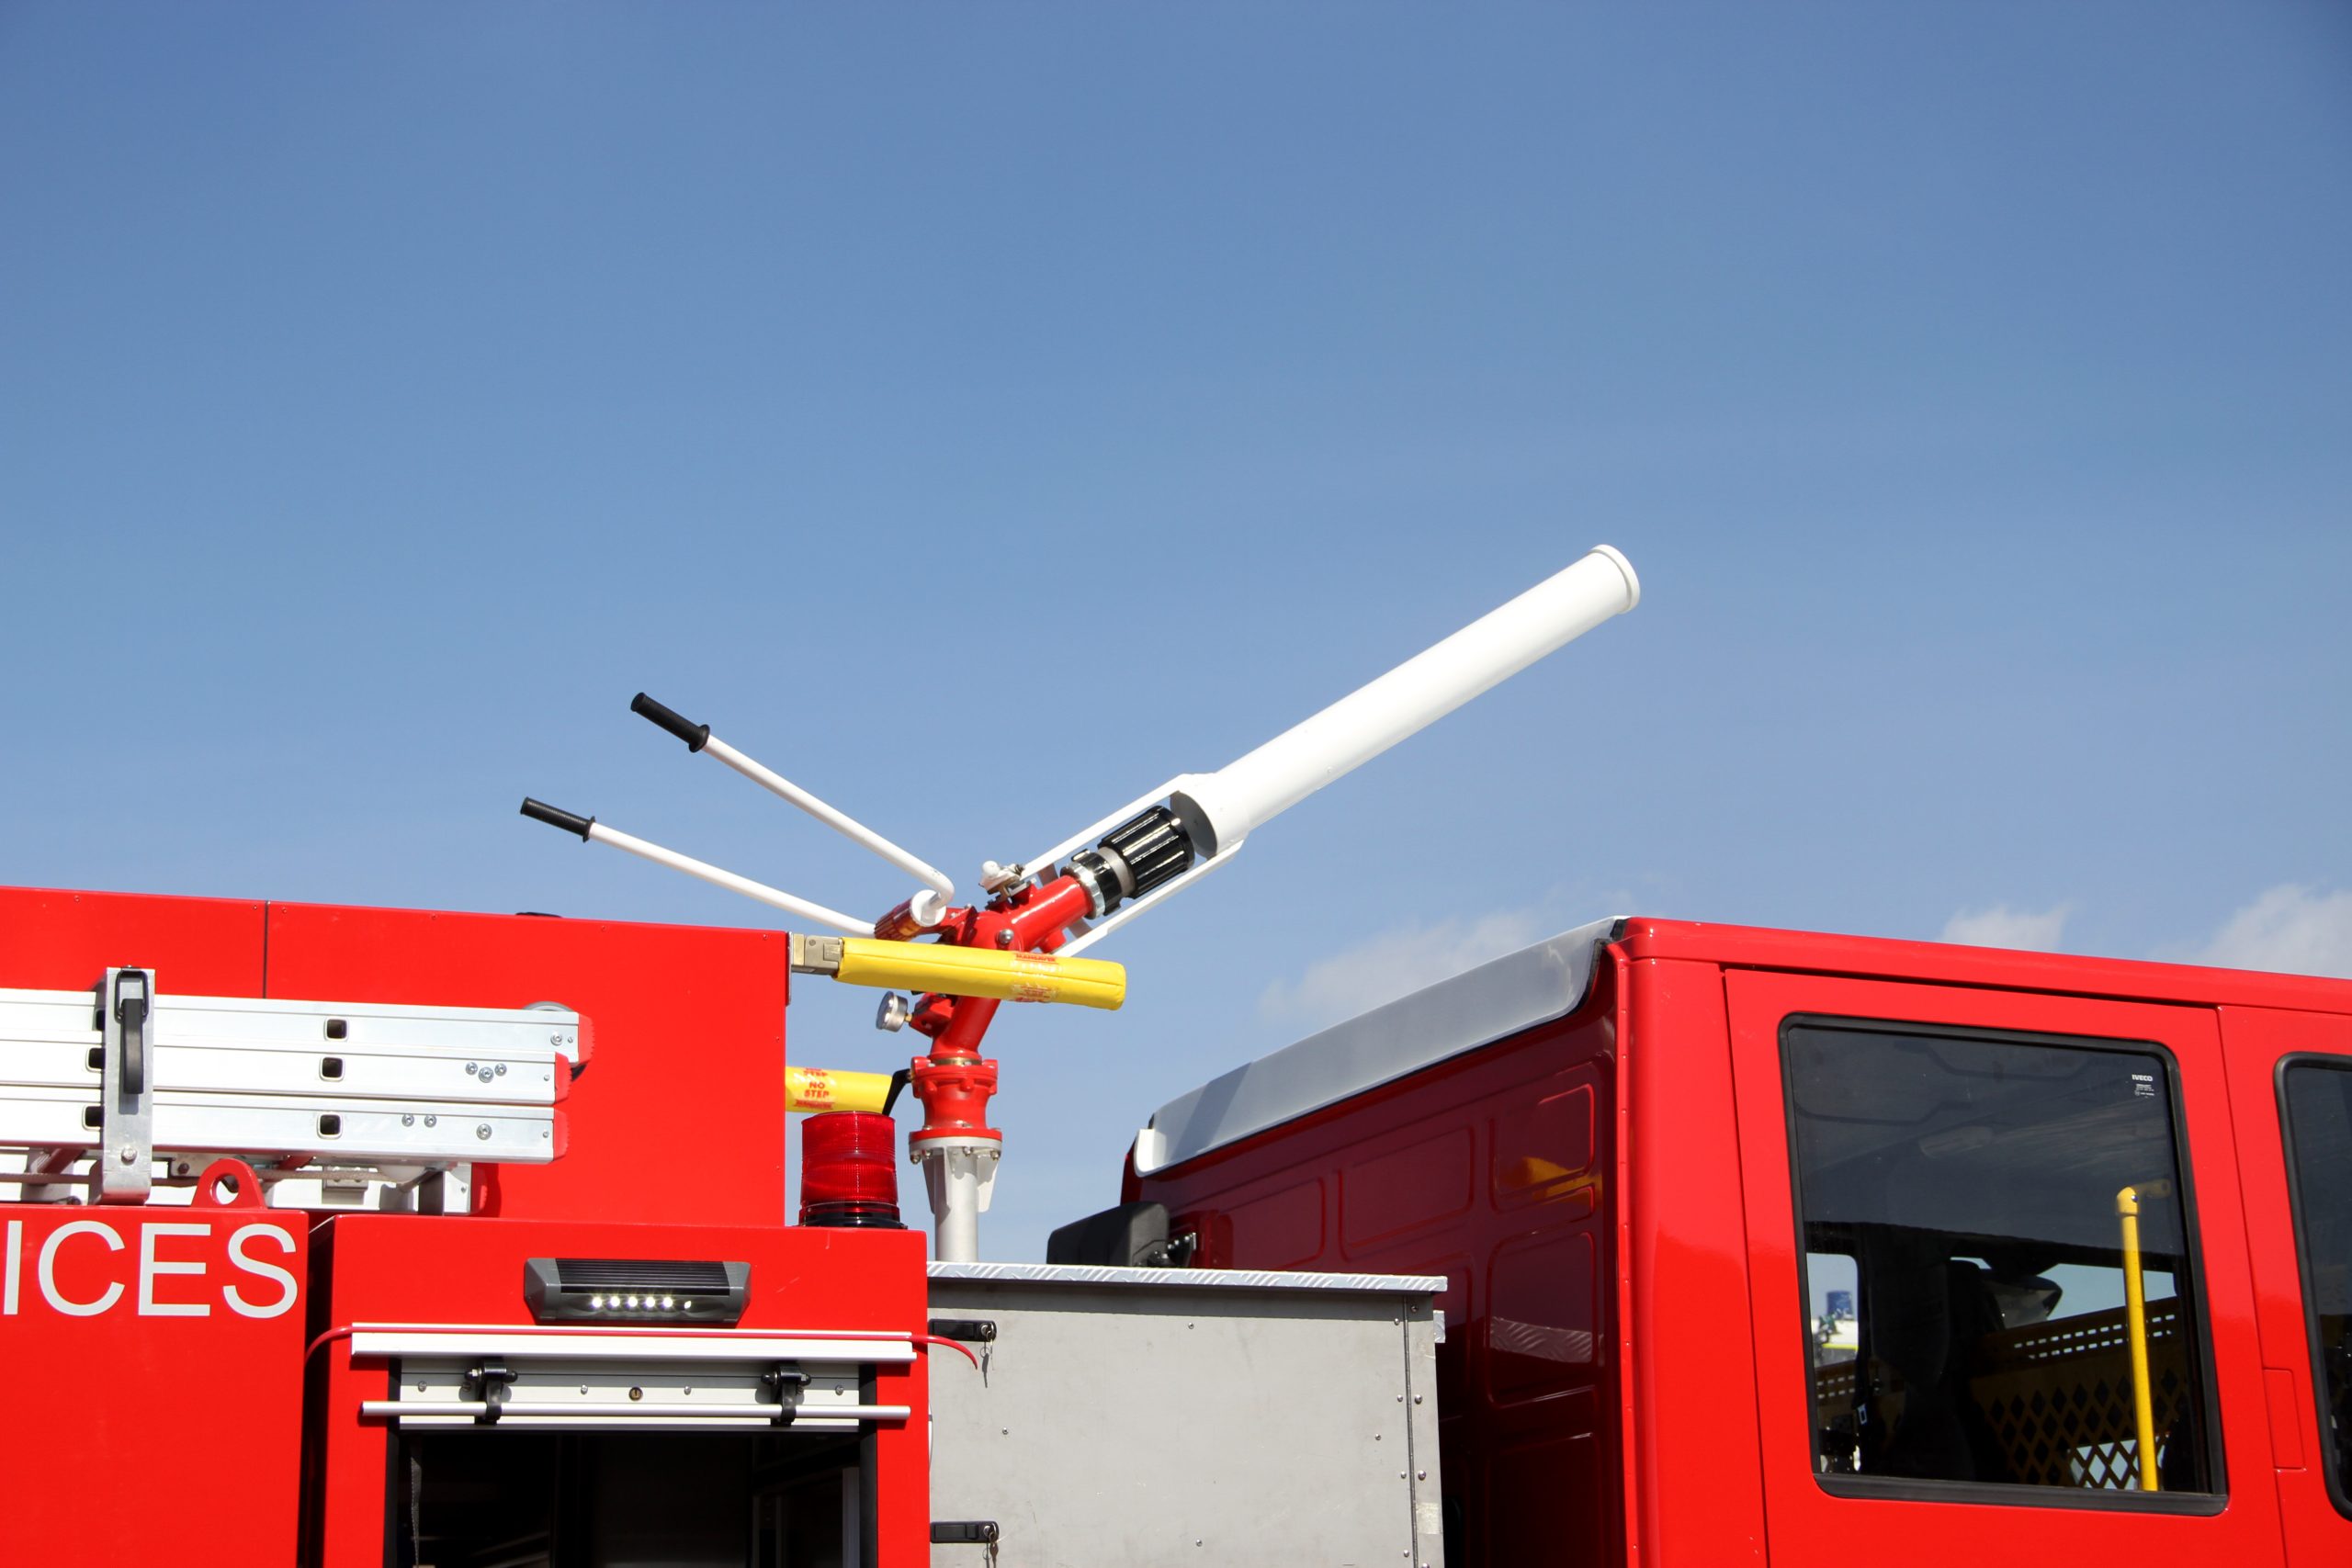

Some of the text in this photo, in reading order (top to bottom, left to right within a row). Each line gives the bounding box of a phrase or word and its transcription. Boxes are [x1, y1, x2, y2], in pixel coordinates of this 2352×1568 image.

[2132, 1074, 2154, 1082] IVECO
[804, 1089, 830, 1099] STEP
[4, 1220, 298, 1318] ICES
